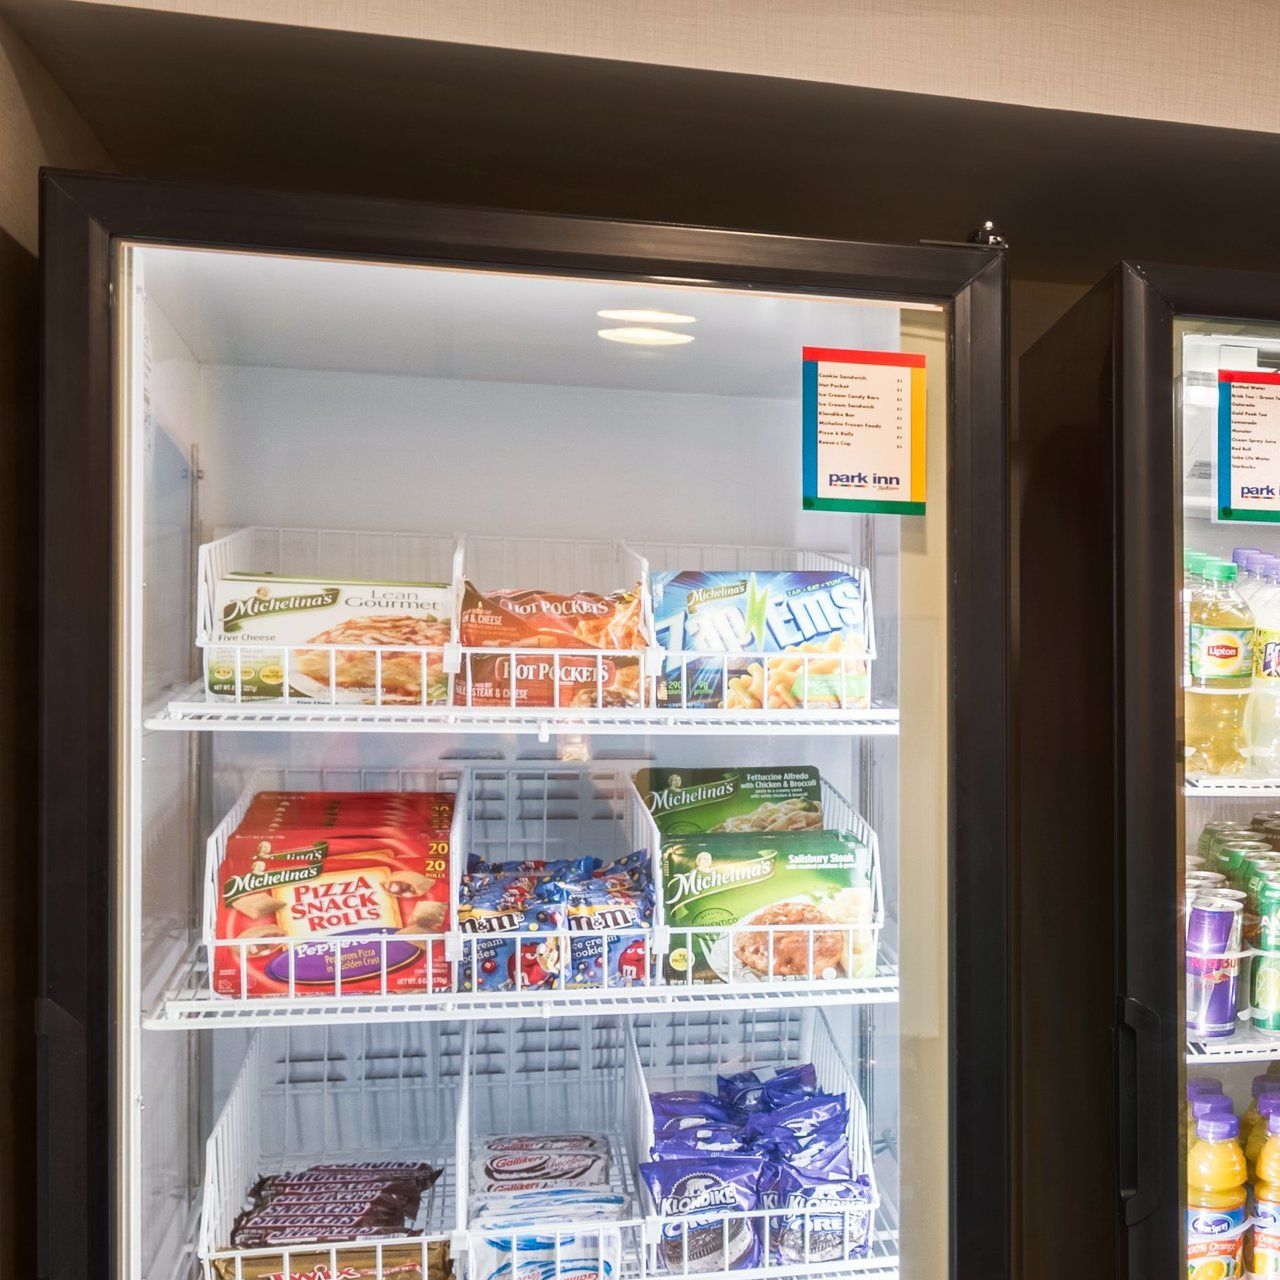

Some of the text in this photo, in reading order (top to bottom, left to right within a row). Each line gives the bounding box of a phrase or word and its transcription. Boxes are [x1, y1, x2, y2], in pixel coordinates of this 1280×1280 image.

[829, 472, 901, 487] park inn
[1240, 484, 1275, 499] park
[372, 589, 419, 600] Lean
[687, 583, 746, 606] Michelina's
[219, 592, 334, 621] Michelina's
[344, 597, 438, 611] Gourmet
[508, 600, 609, 617] HOT POCKETS
[218, 633, 276, 642] Five Cheese
[1208, 646, 1238, 657] Lipton
[472, 687, 493, 697] STEAK
[746, 772, 809, 781] Fettuccine Alfredo
[755, 779, 817, 789] Chicken Broccoli
[650, 781, 734, 813] Michelina's
[425, 859, 446, 872] 20
[223, 866, 318, 898] Michelina's
[293, 876, 372, 903] PIZZA
[666, 859, 772, 905] Michelina's
[291, 892, 379, 920] SNACK
[308, 908, 381, 932] ROLLS
[661, 1189, 737, 1216] KLONDIKE
